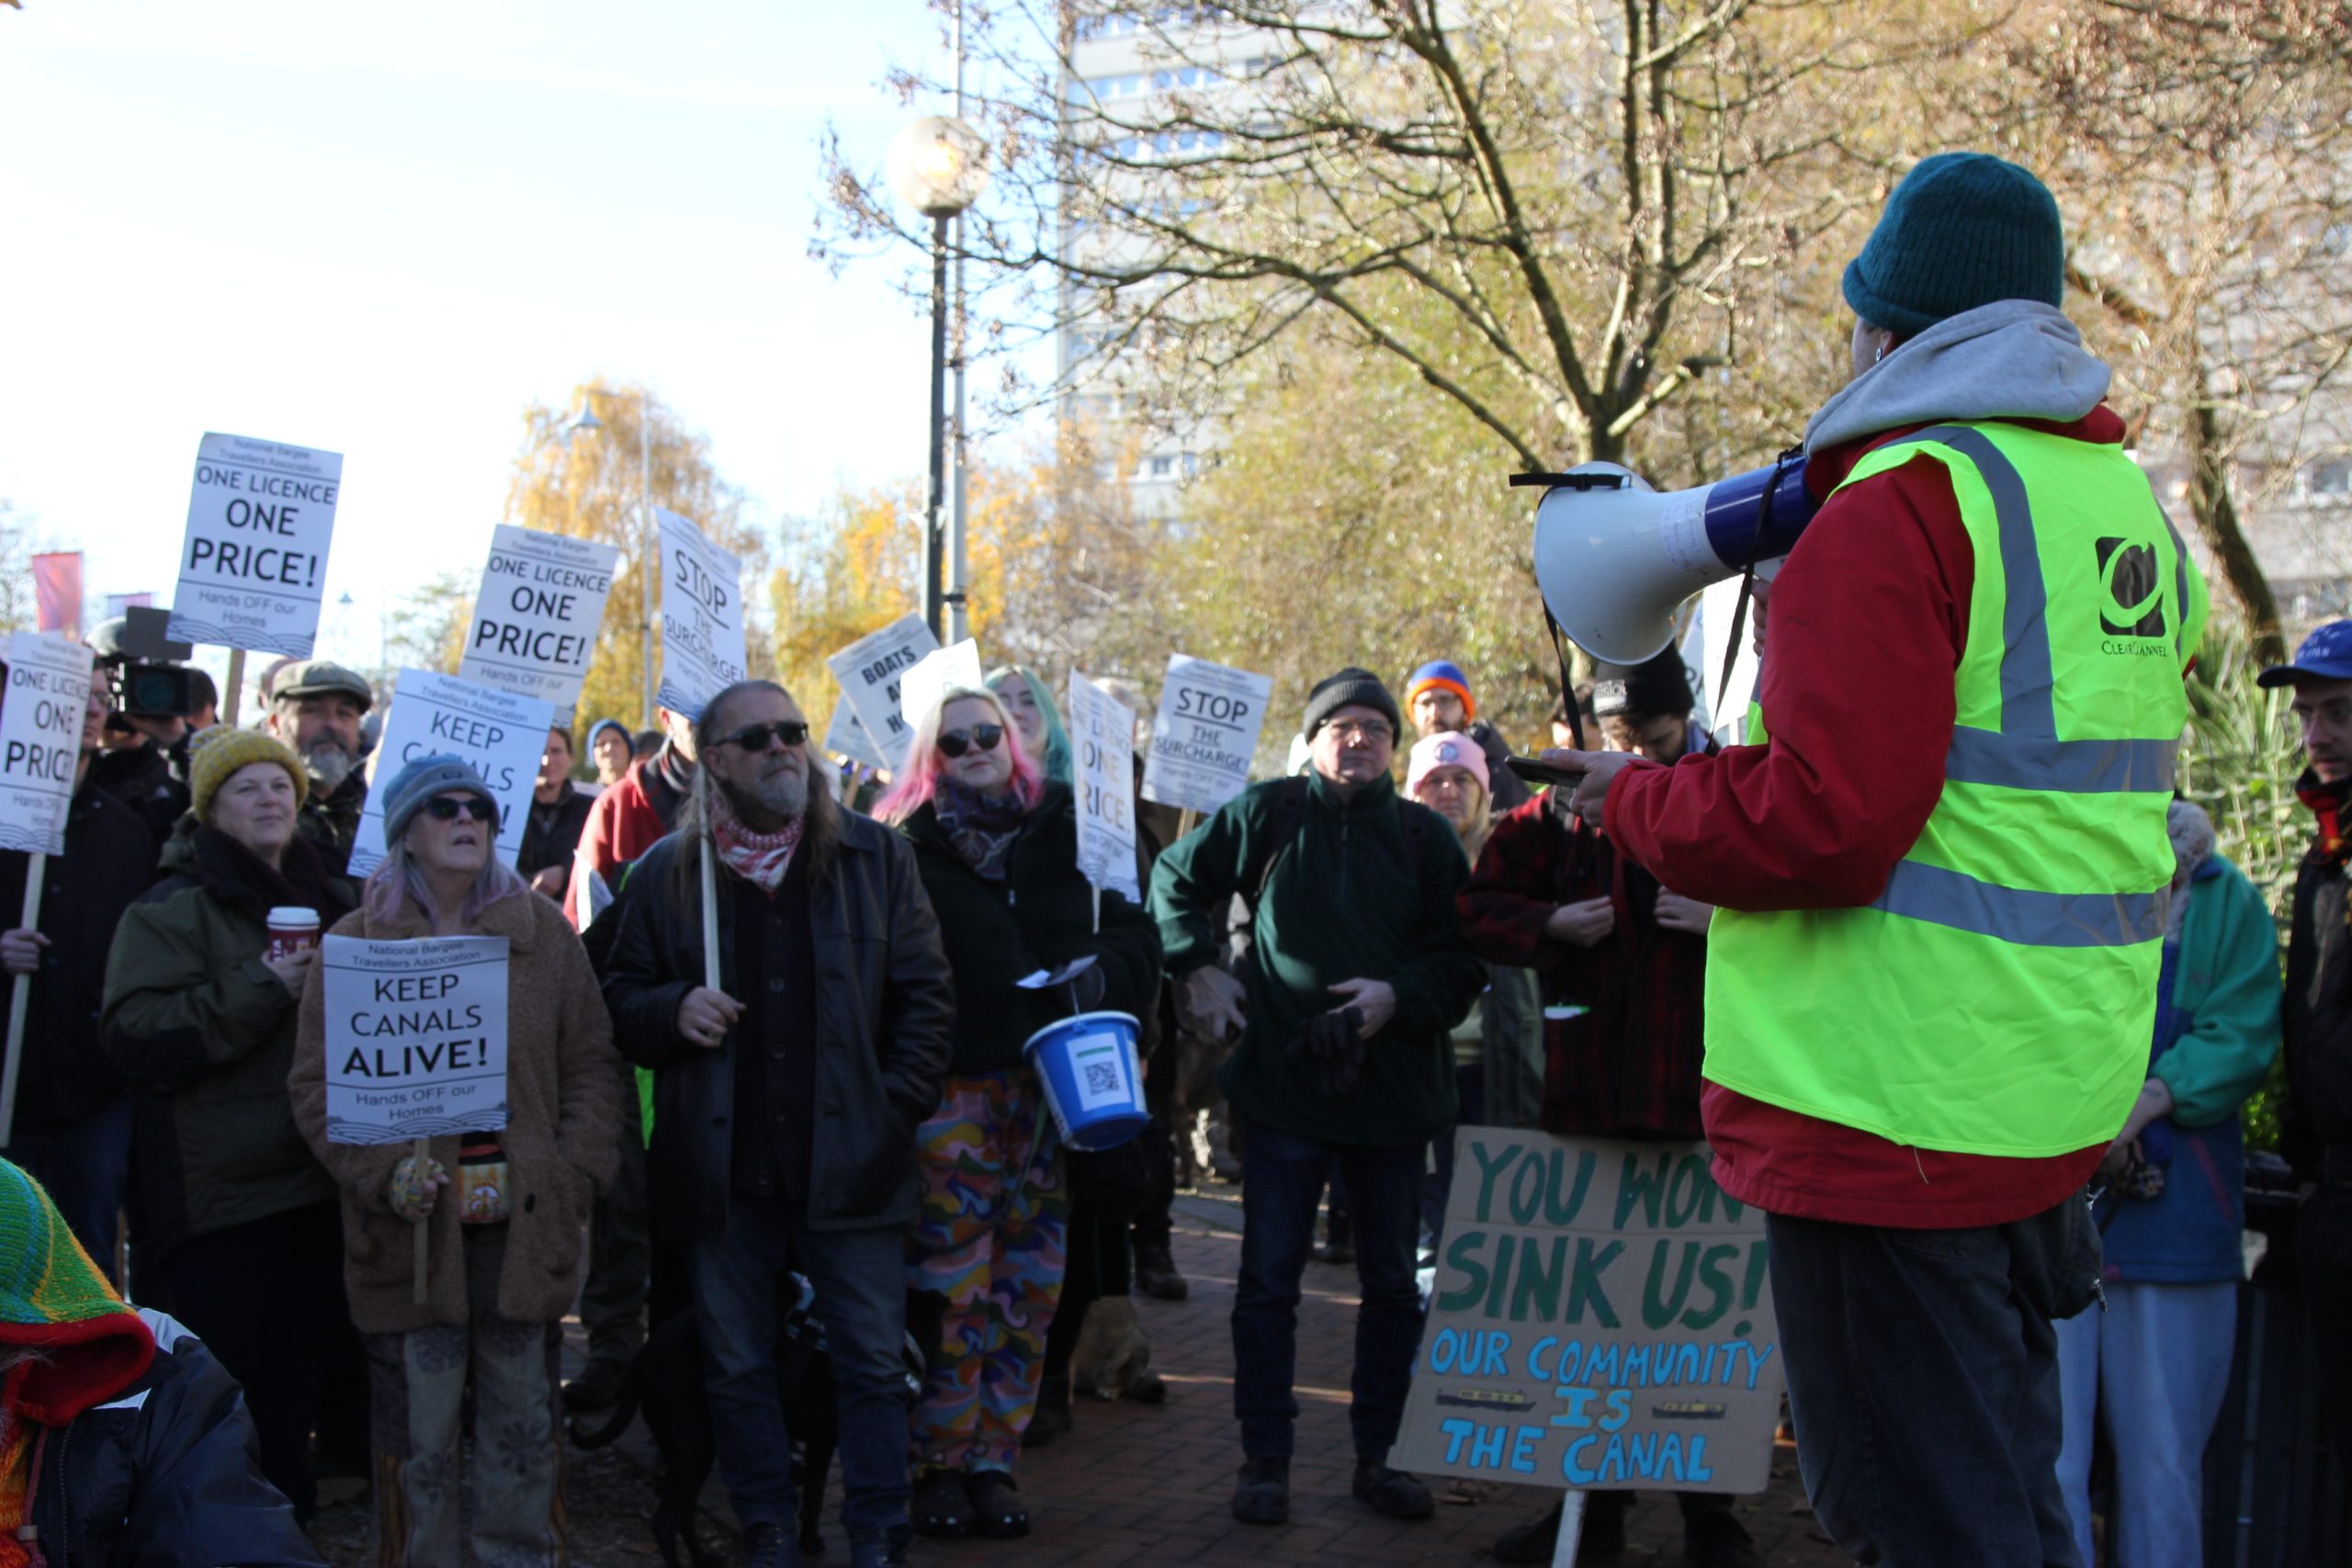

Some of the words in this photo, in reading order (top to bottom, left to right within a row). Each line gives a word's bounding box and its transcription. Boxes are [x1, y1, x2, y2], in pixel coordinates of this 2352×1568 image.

[197, 466, 242, 490] ONE
[249, 474, 336, 505] LICENCE
[226, 499, 300, 536] ONE
[188, 537, 318, 588] PRICE!
[490, 556, 529, 577] ONE
[534, 565, 608, 592] LICENCE
[198, 589, 241, 607] Hands
[243, 595, 273, 610] OFF
[675, 549, 727, 615] STOP
[221, 610, 266, 627] Homes
[511, 586, 577, 621] ONE
[475, 619, 585, 666] PRICE!
[13, 668, 47, 691] ONE
[481, 666, 518, 682] Hands
[521, 673, 547, 687] OFF
[862, 645, 916, 685] BOATS
[422, 685, 469, 706] Travellers
[471, 702, 528, 723] Association
[438, 677, 480, 696] National
[481, 690, 517, 708] Bargee
[1177, 687, 1248, 722] STOP
[431, 710, 503, 750] KEEP
[1192, 725, 1223, 744] THE
[353, 955, 410, 968] Travellers
[413, 951, 481, 966] Association
[369, 943, 418, 955] National
[422, 942, 465, 955] Bargee
[374, 974, 458, 1002] KEEP
[351, 1004, 482, 1037] CANALS
[342, 1037, 487, 1077] ALIVE!
[356, 1092, 407, 1105] Hands
[413, 1086, 447, 1101] OFF
[451, 1084, 477, 1096] our
[390, 1104, 445, 1120] Homes
[1472, 1142, 1596, 1225] YOU
[1614, 1148, 1744, 1230] WON
[1436, 1232, 1626, 1329] SINK
[1641, 1238, 1769, 1338] US!
[1430, 1328, 1510, 1375] OUR
[1550, 1386, 1633, 1432] IS
[1440, 1419, 1545, 1472] THE
[1564, 1434, 1713, 1484] CANAL
